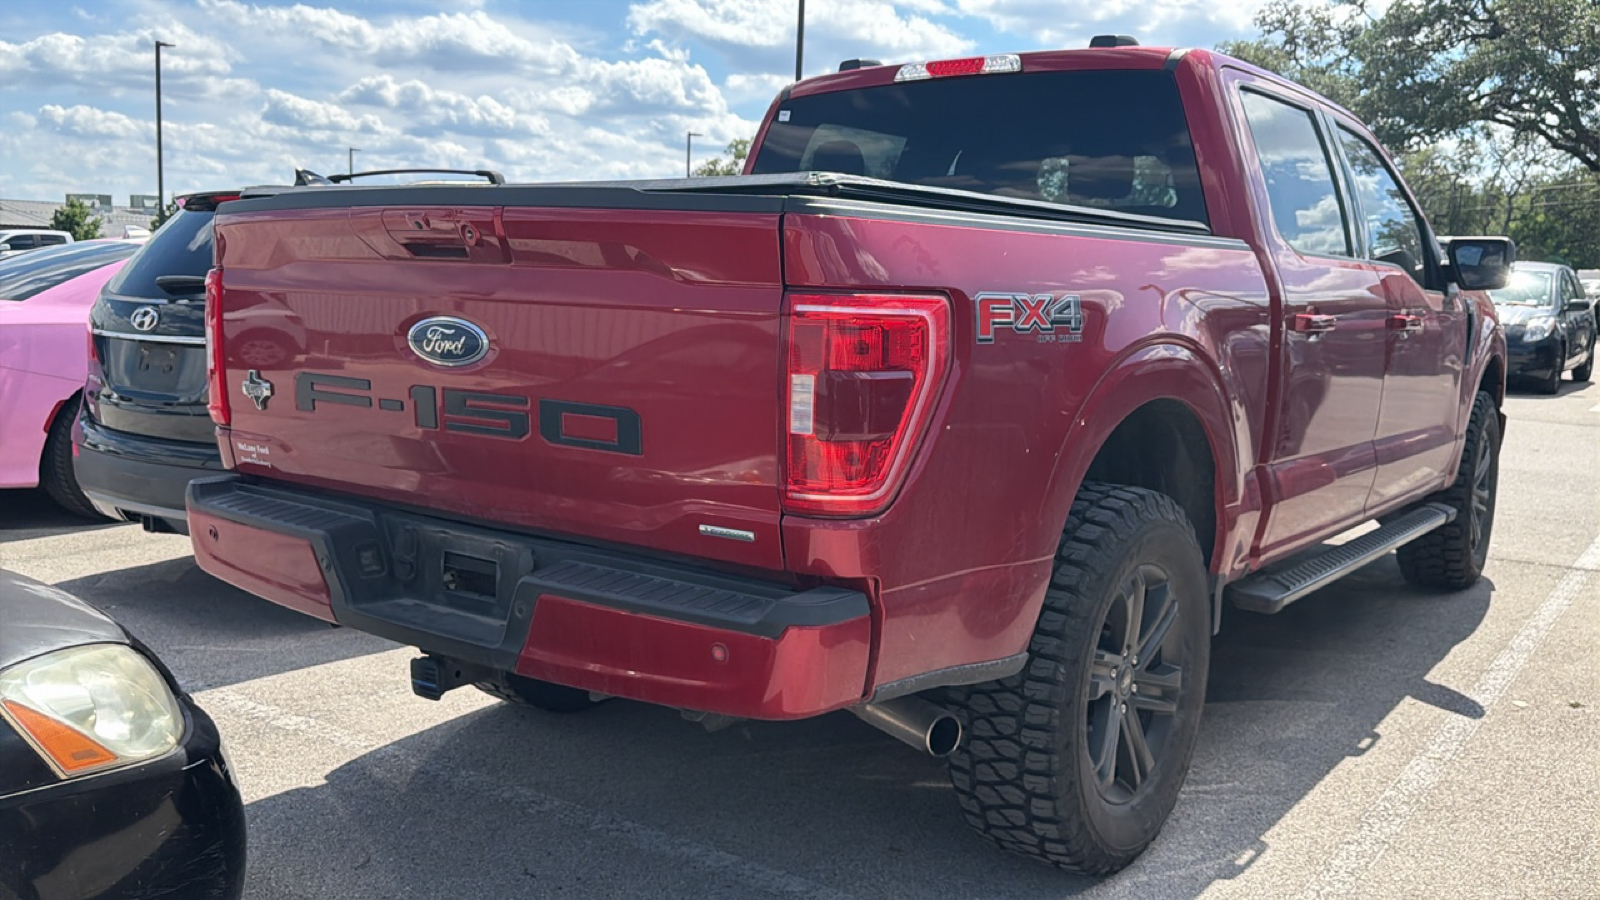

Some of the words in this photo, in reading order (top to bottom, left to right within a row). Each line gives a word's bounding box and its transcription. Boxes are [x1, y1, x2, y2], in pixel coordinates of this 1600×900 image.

[423, 326, 466, 355] Ford
[975, 291, 1082, 344] FX4
[295, 371, 643, 456] F-150
